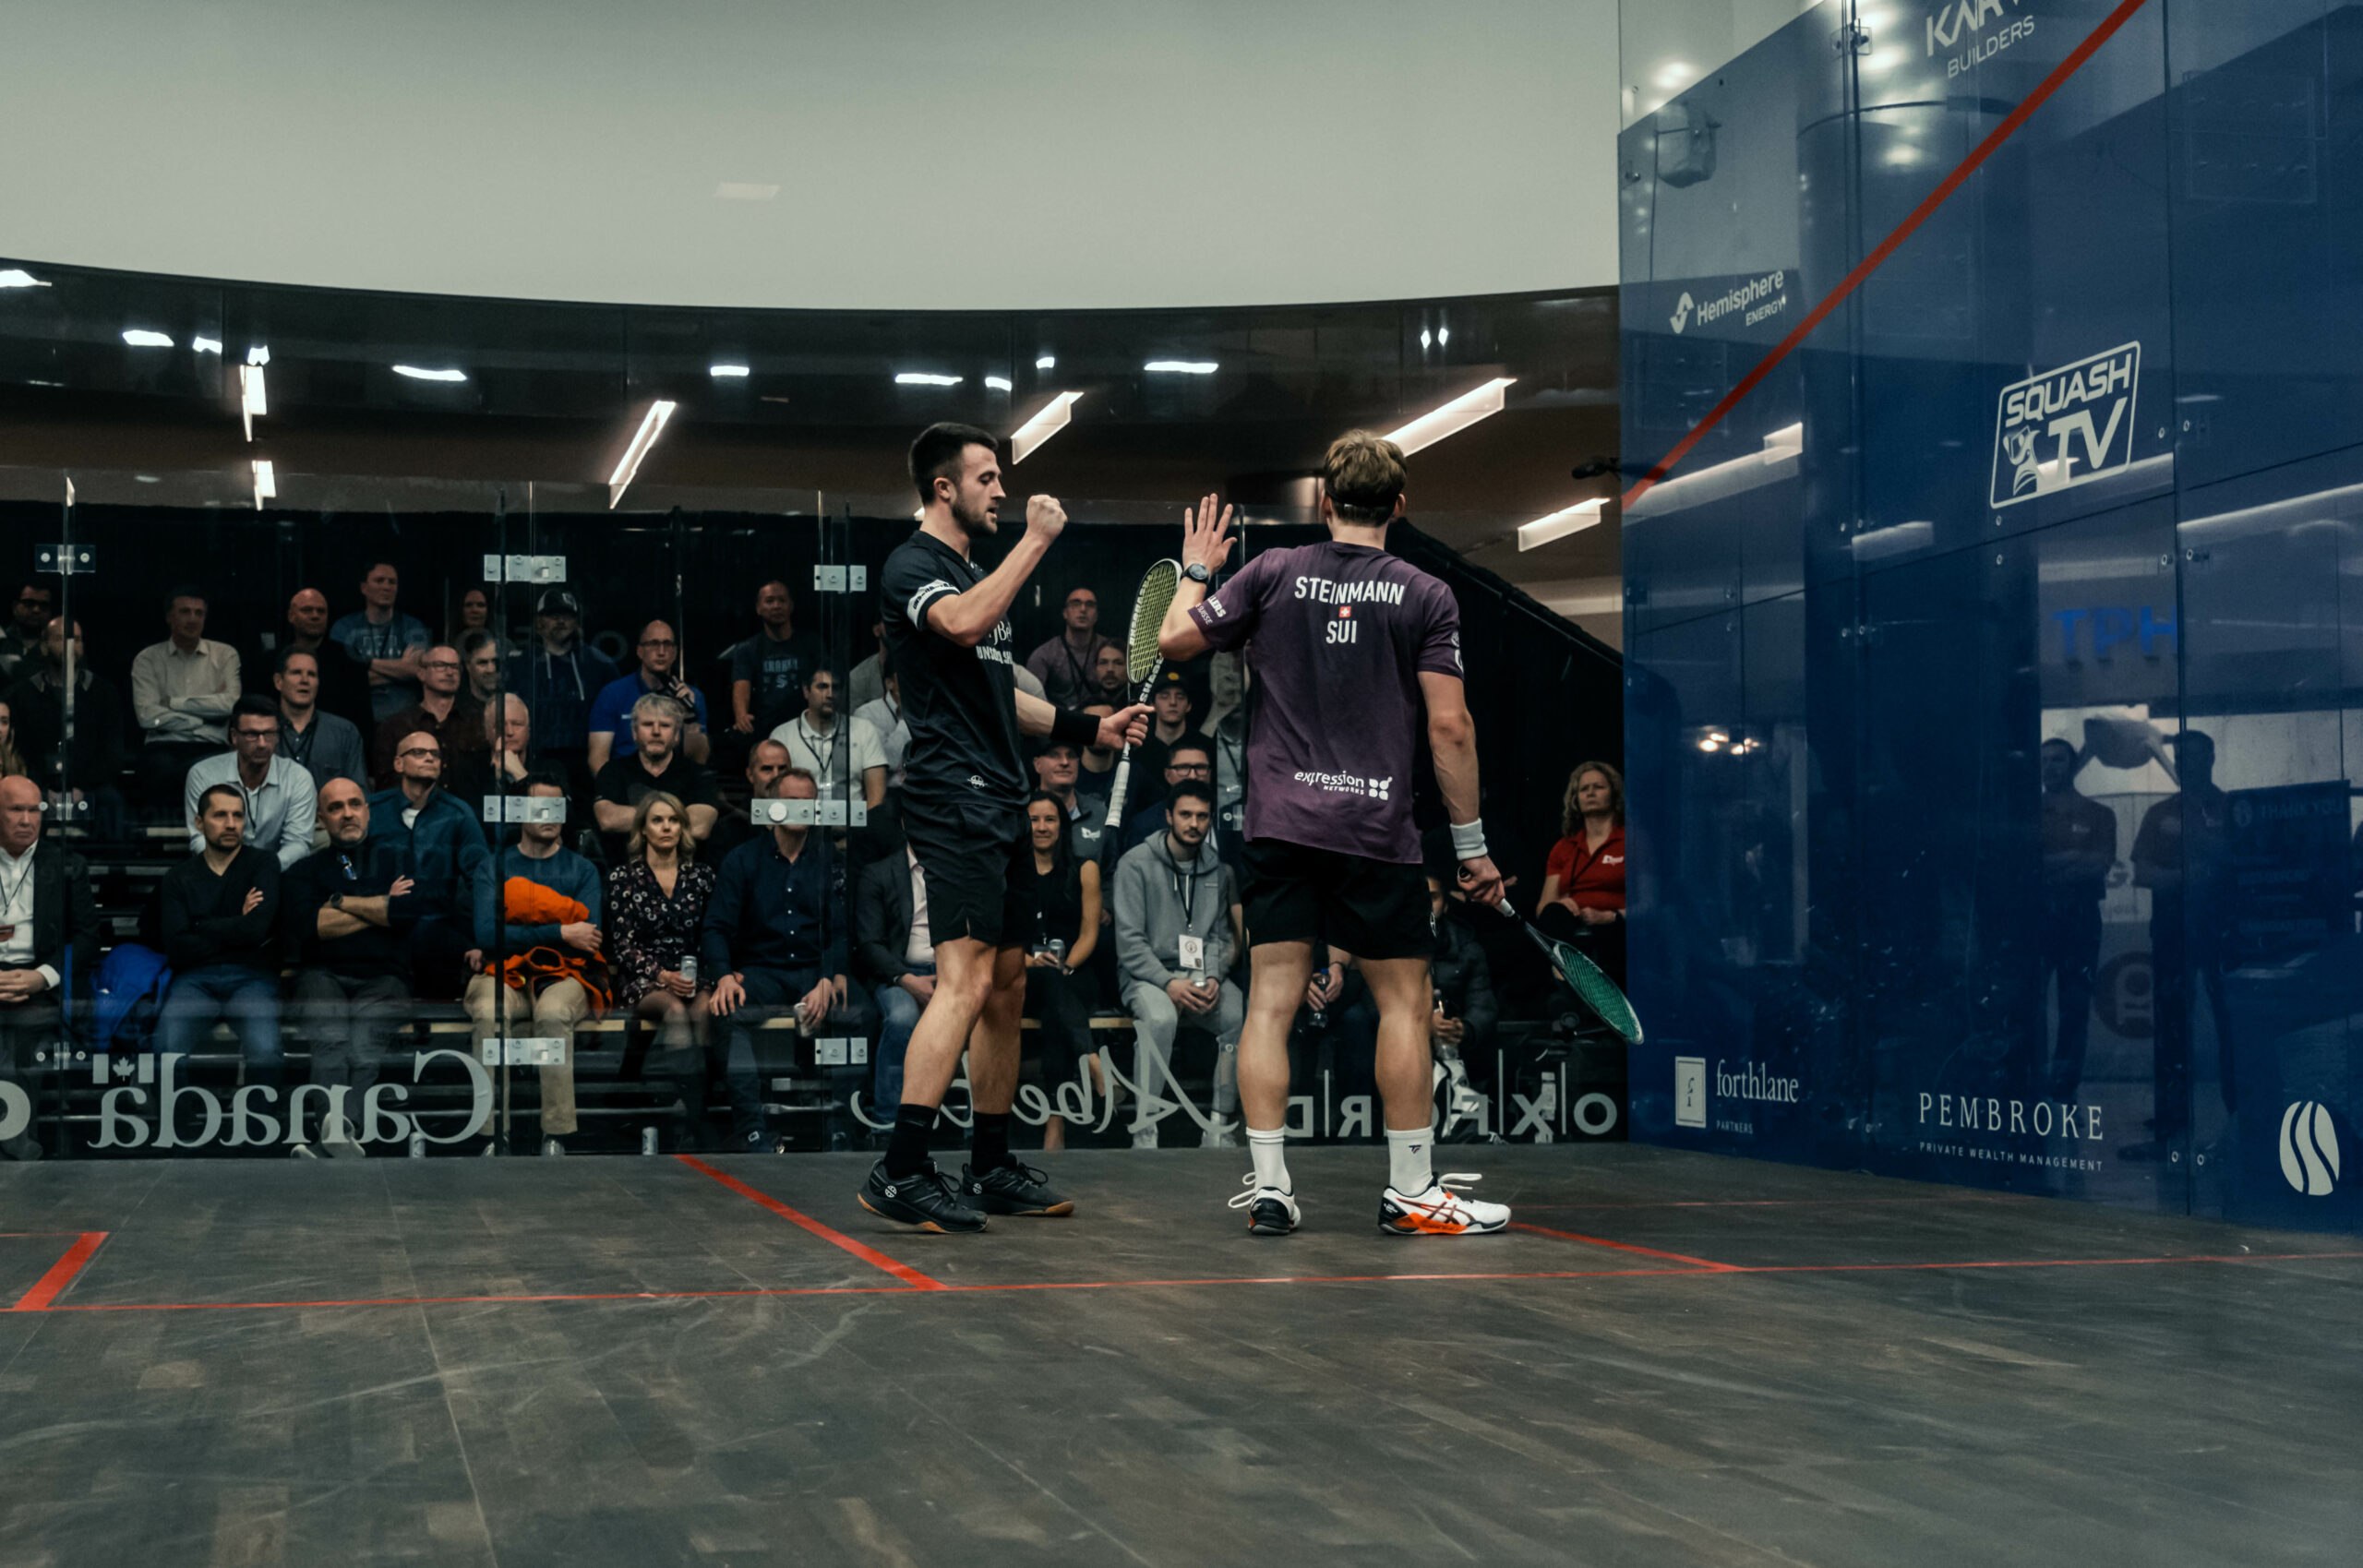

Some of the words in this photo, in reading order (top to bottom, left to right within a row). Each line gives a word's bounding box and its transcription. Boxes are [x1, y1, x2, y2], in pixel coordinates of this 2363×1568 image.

[1947, 15, 2035, 78] BUILDERS
[1697, 269, 1784, 327] Hemisphere
[1745, 300, 1784, 327] ENERGY
[2005, 353, 2132, 428] SQUASH
[2047, 395, 2129, 483] TV
[1293, 575, 1406, 605] STEINMANN
[1325, 620, 1358, 643] SUI
[1294, 770, 1364, 789] expression
[1323, 784, 1364, 796] NETWORKS
[1716, 1058, 1799, 1104] forthlane
[1716, 1119, 1754, 1135] PARTNERS
[1918, 1092, 2104, 1141] PEMBROKE
[1919, 1141, 1964, 1157] PRIVATE
[1969, 1148, 2014, 1163] WEALTH
[2019, 1153, 2103, 1172] MANAGEMENT
